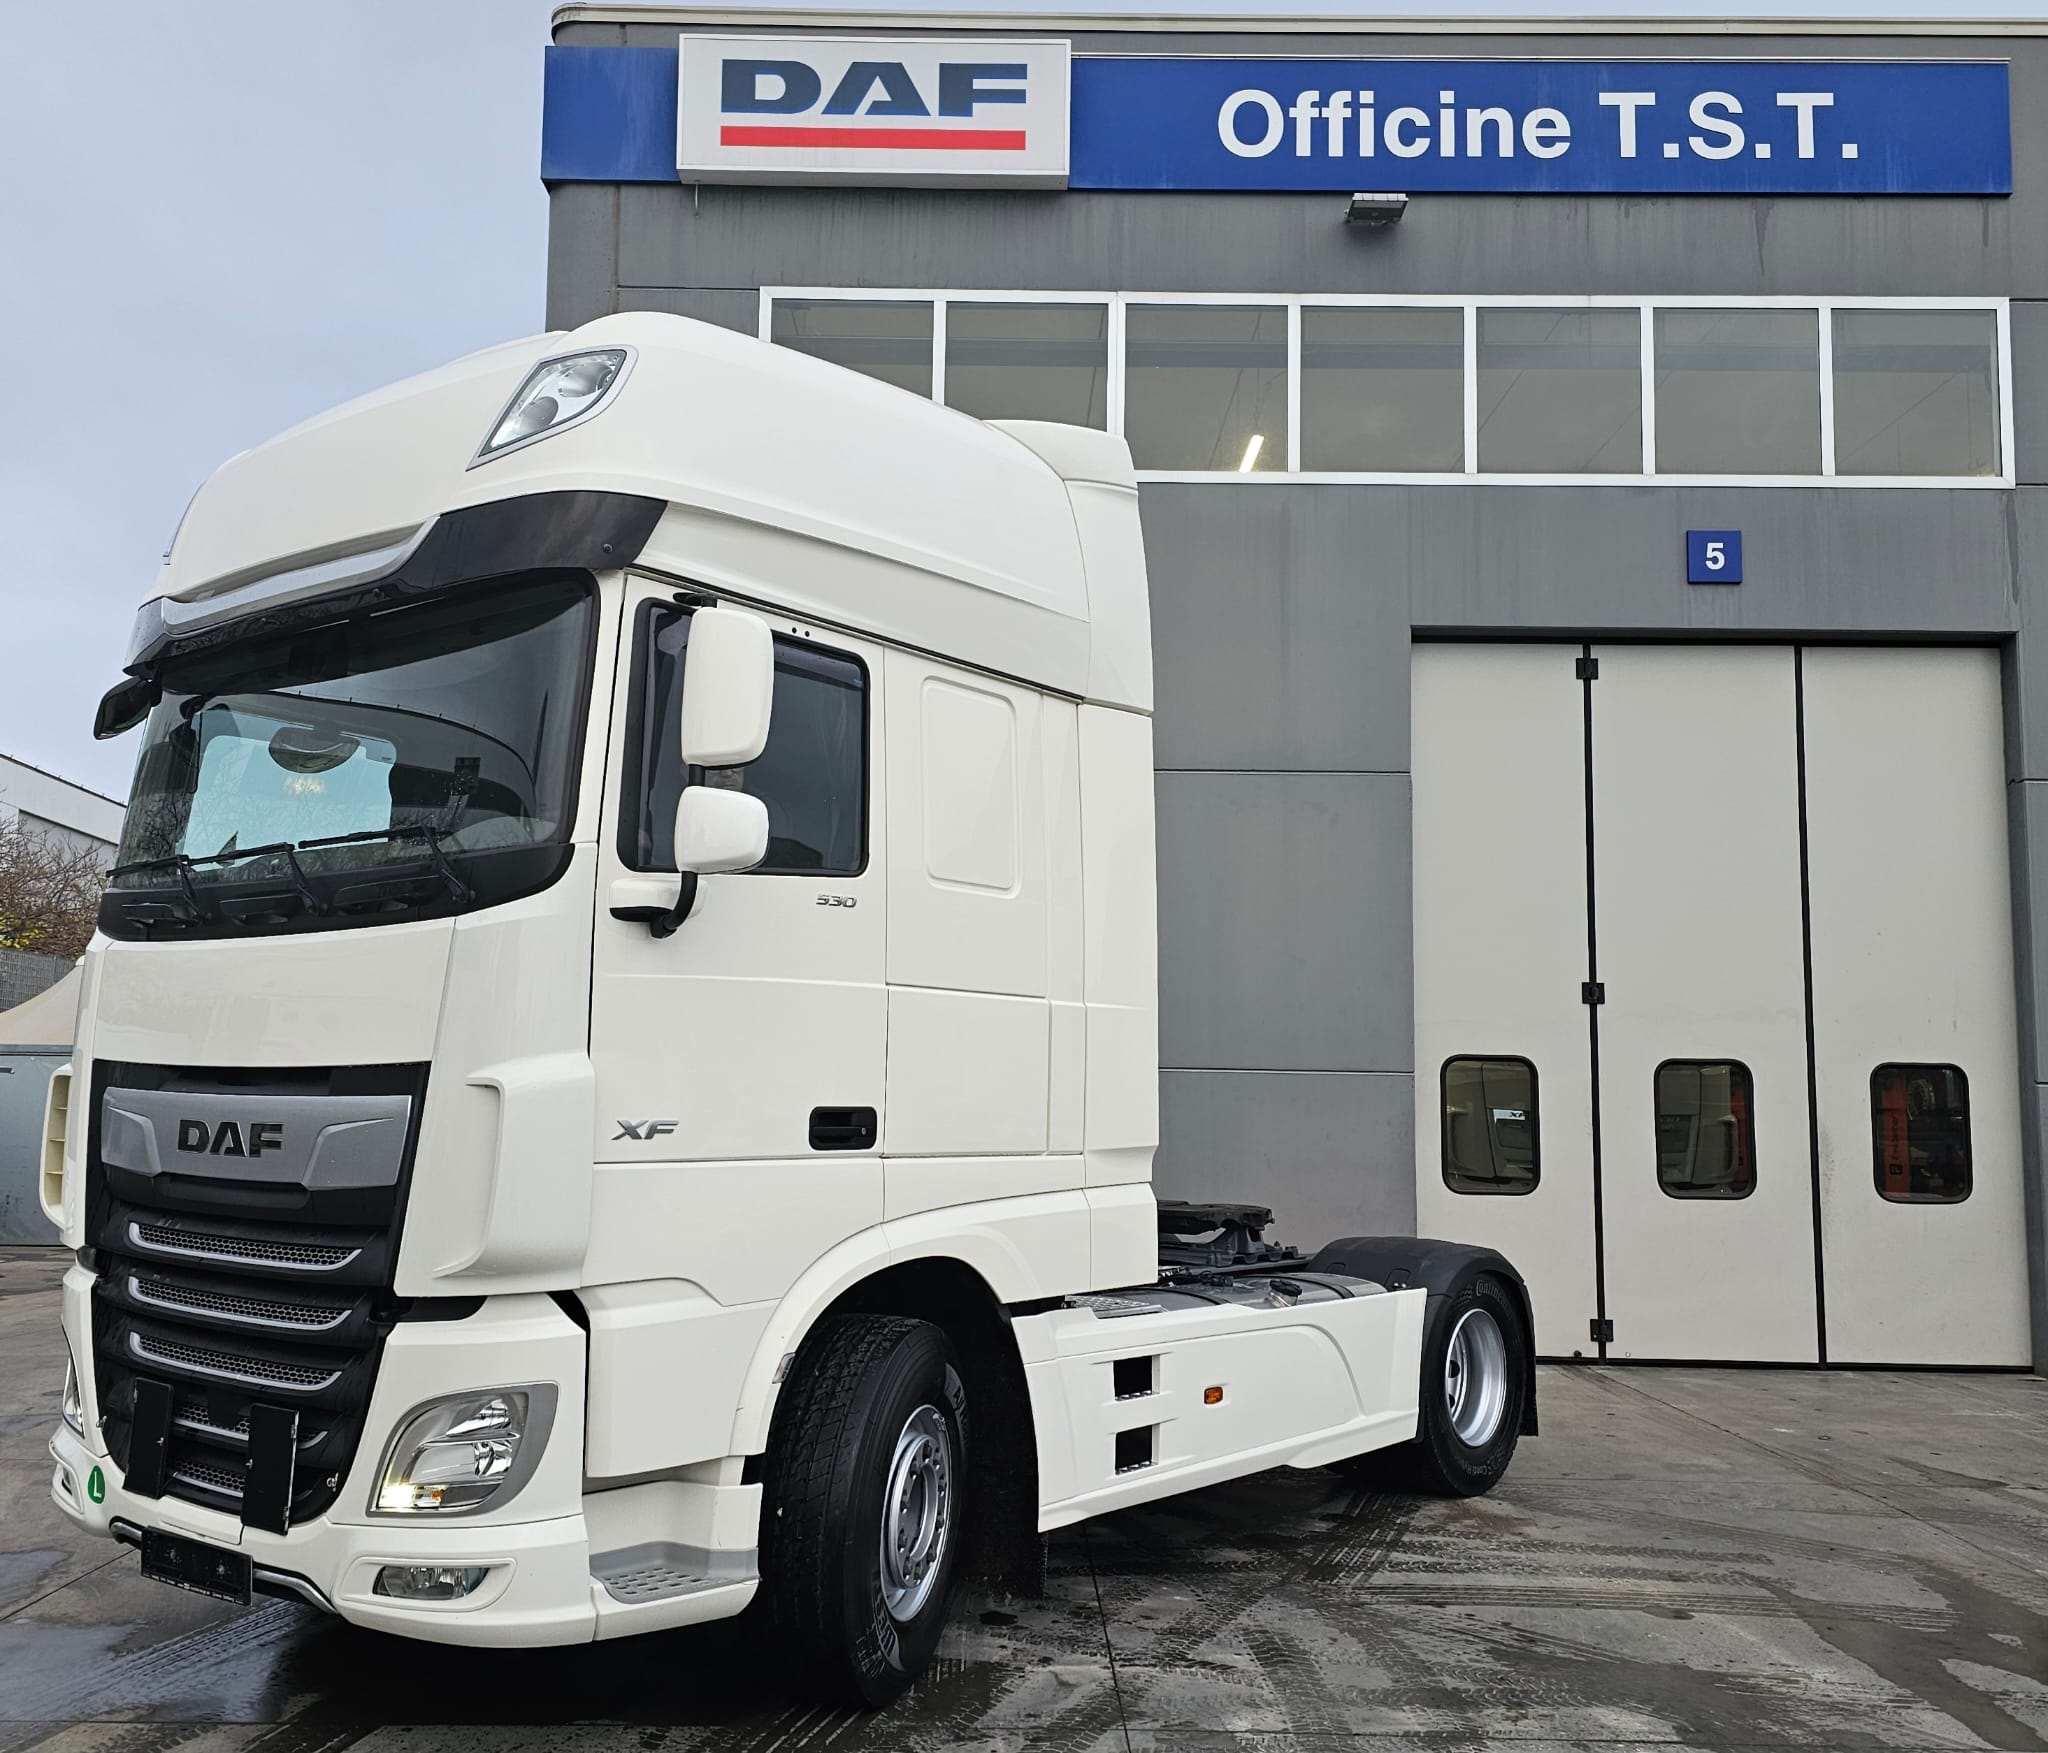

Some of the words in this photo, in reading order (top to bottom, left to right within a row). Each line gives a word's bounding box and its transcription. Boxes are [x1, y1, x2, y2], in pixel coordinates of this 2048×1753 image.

[721, 59, 1027, 117] DAF
[1219, 90, 1570, 158] Officine
[1599, 92, 1857, 159] T.S.T.
[1706, 543, 1724, 569] 5
[816, 894, 857, 908] 530
[177, 1120, 284, 1158] DAF
[611, 1119, 679, 1140] XF
[93, 1471, 102, 1498] L
